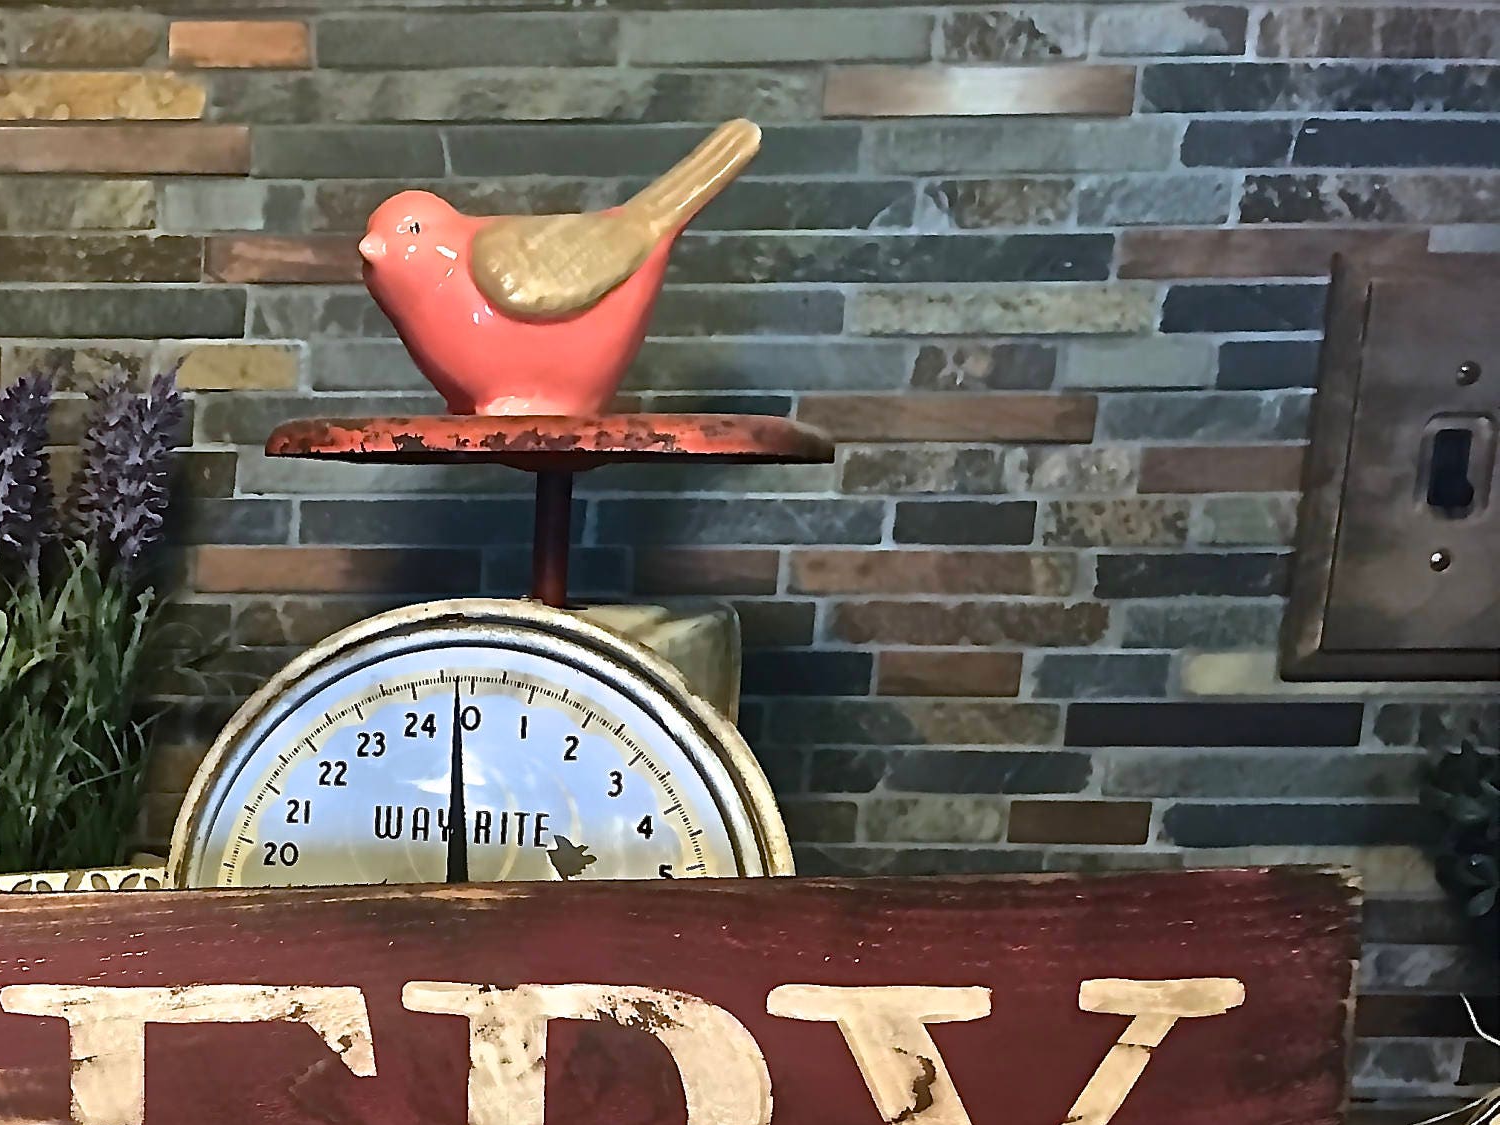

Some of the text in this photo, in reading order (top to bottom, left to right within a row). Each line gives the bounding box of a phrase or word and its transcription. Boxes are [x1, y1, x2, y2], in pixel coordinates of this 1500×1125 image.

[263, 842, 299, 867] 20
[285, 799, 311, 825] 21
[318, 760, 347, 786] 22
[356, 732, 386, 758] 23
[404, 712, 437, 738] 24
[460, 705, 481, 731] 0
[520, 715, 528, 739] 1
[563, 735, 580, 761] 2
[607, 771, 623, 797] 3
[637, 814, 653, 839] 4
